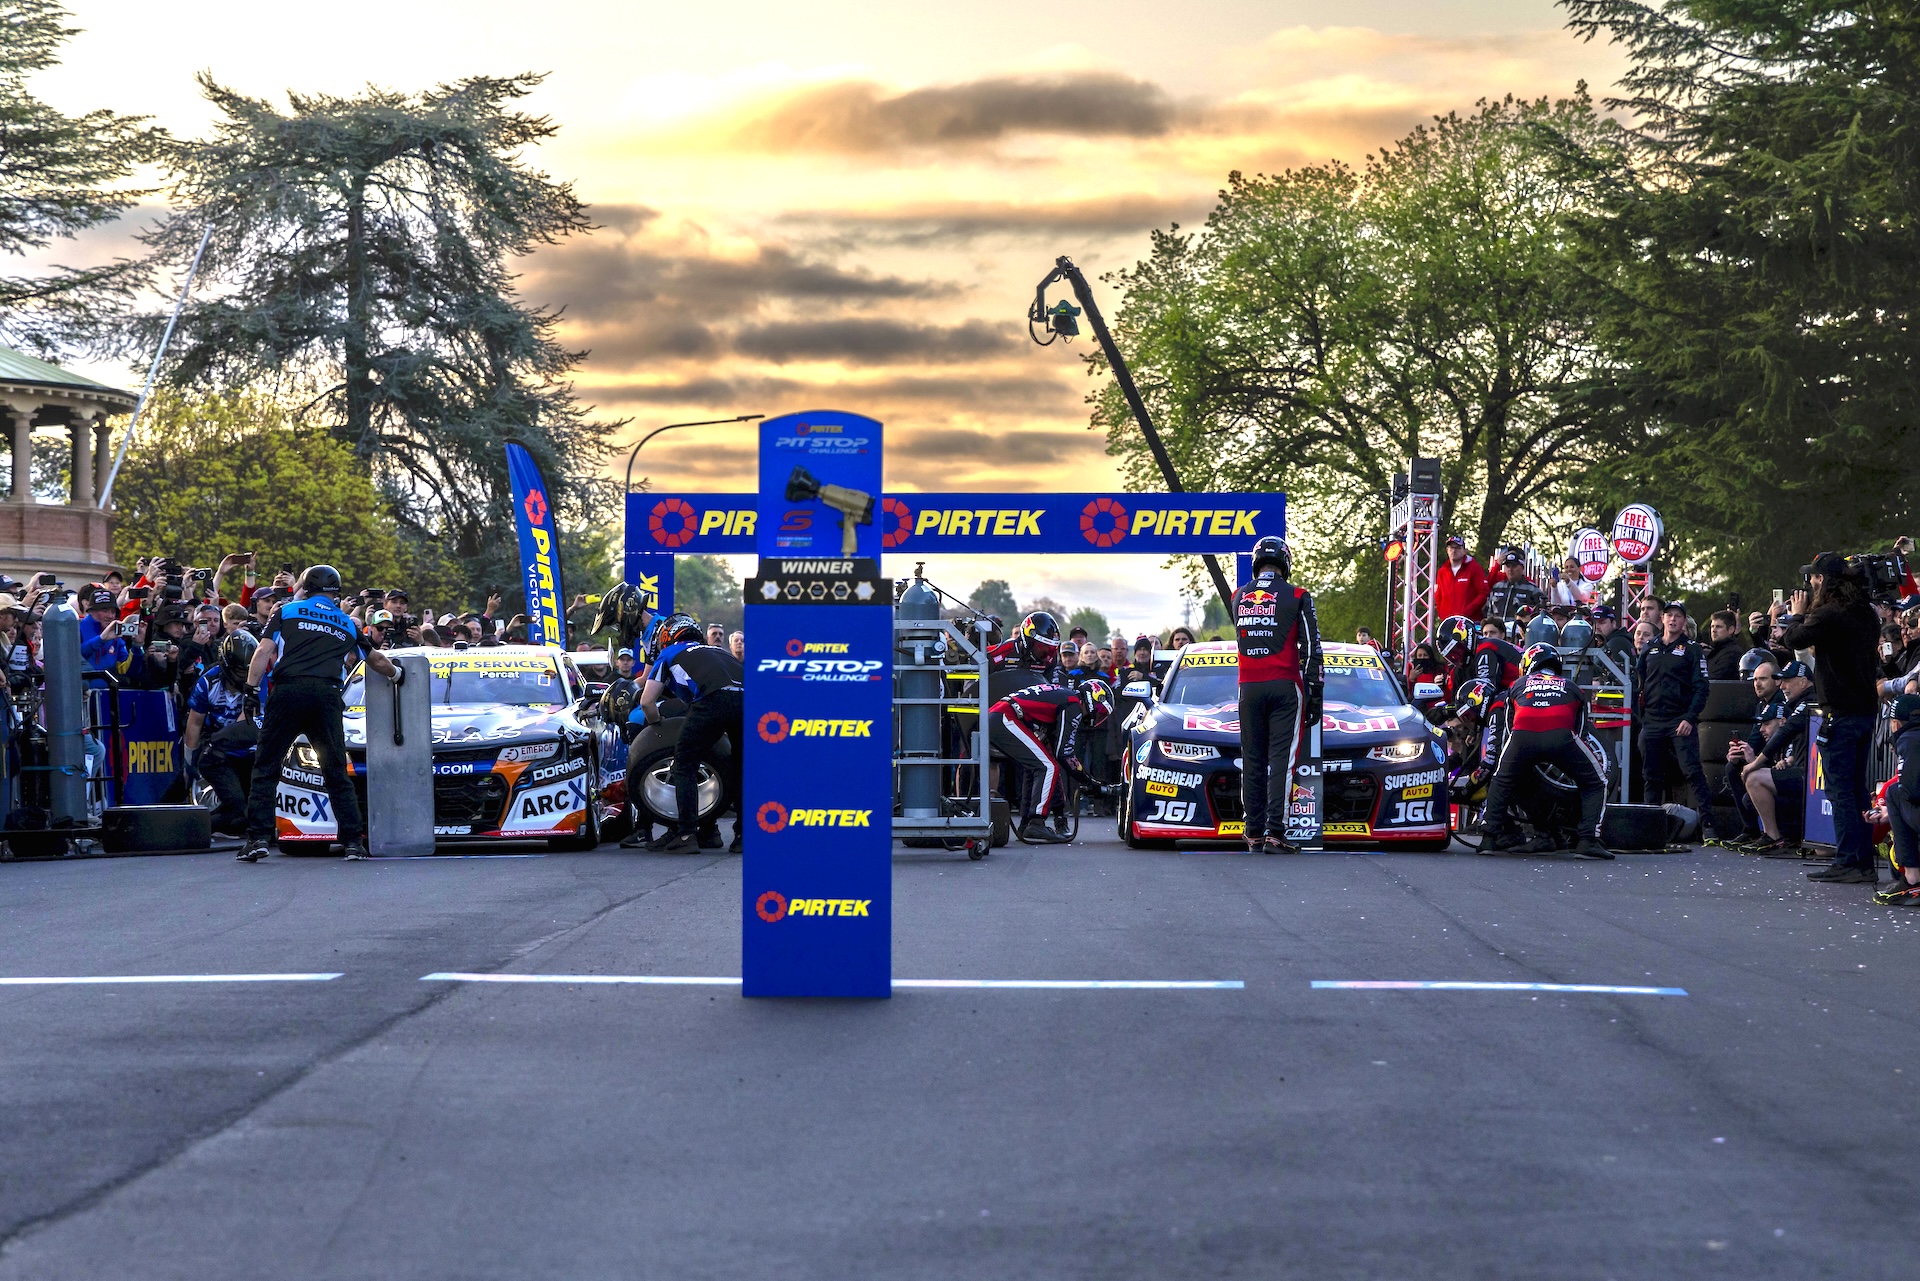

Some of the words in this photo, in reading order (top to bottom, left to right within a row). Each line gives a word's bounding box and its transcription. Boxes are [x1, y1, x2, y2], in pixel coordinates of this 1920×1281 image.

[914, 509, 1046, 536] PIRTEK
[1130, 509, 1262, 536] PIRTEK
[1624, 512, 1648, 528] FREE
[1614, 525, 1633, 540] MEAT
[1635, 528, 1653, 546] TRAY
[1584, 537, 1602, 550] FREE
[781, 561, 855, 574] WINNER
[1238, 604, 1257, 616] Red
[1257, 604, 1276, 616] Bull
[298, 607, 349, 629] Bendix
[1237, 616, 1278, 627] AMPOL
[298, 621, 347, 642] SUPAGLASS
[804, 643, 850, 653] PIRTEK
[1247, 647, 1270, 656] DUTTO
[474, 659, 548, 669] SERVICES
[757, 659, 806, 672] PIT
[805, 660, 883, 673] STOP
[479, 671, 520, 679] Percat
[802, 673, 870, 682] CHALLENGE
[789, 719, 873, 737] PIRTEK
[521, 743, 554, 755] EMERGE
[1174, 744, 1214, 757] WÜRTH
[128, 741, 175, 773] PIRTEK
[532, 756, 586, 781] DORMER
[1136, 764, 1203, 789] SUPERCHEAP
[1384, 767, 1445, 791] SUPERCHEAP
[1149, 784, 1174, 794] AUTO
[1405, 787, 1429, 797] AUTO
[1146, 800, 1197, 822] JGI
[1292, 801, 1316, 815] Bull
[788, 809, 873, 827] PIRTEK
[788, 899, 872, 917] PIRTEK
